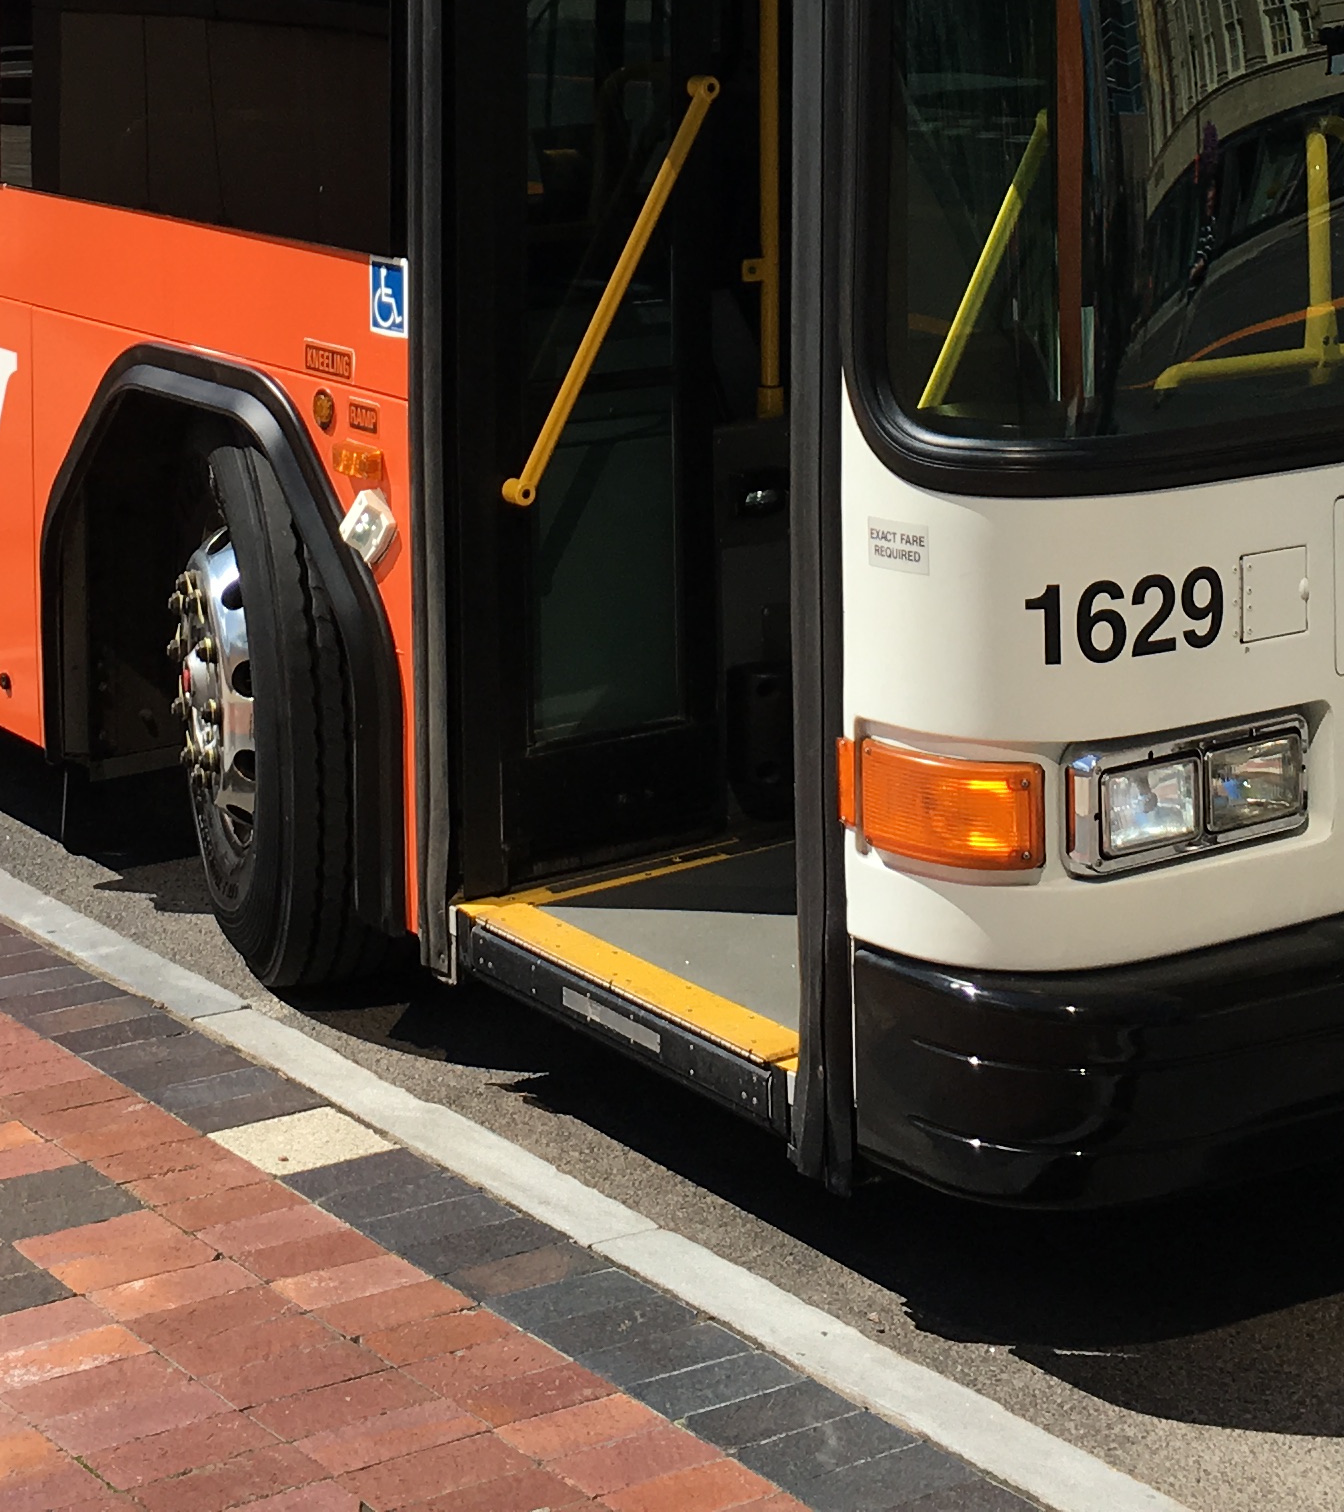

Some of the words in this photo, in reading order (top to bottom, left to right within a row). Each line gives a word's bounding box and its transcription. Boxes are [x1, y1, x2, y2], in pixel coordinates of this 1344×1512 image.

[306, 347, 350, 377] KNEELING
[350, 405, 377, 429] RAMP
[870, 527, 897, 543] EXACT
[900, 533, 925, 547] FARE
[874, 544, 921, 563] REQUIRED
[1024, 565, 1224, 666] 1629
